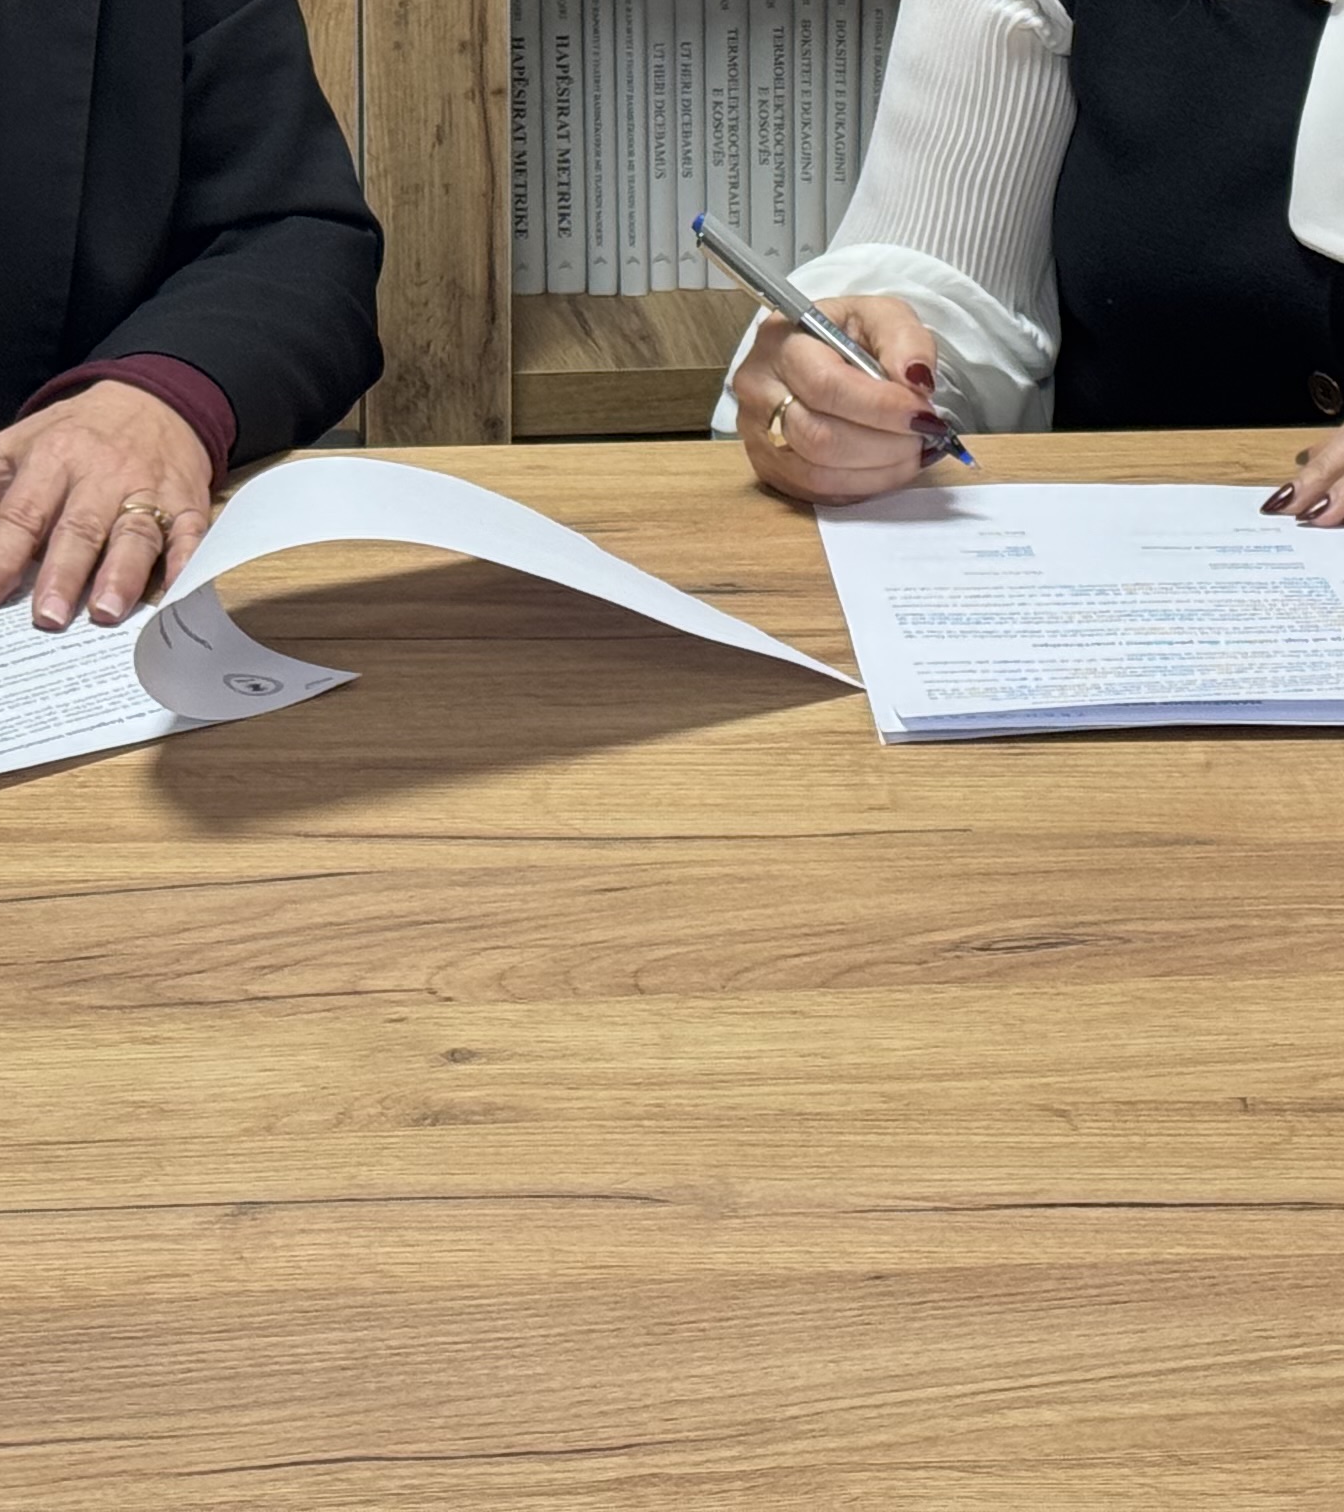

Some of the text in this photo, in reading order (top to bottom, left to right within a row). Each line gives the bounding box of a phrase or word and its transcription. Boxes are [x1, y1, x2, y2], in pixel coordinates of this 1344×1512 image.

[555, 34, 575, 144] HAPËSIRAT
[652, 41, 666, 60] UT
[799, 19, 813, 86] BOKSITET
[834, 19, 848, 85] BOKSITET
[653, 98, 668, 180] DICEBAMUS
[680, 40, 694, 179] UT HERI DICEBAMUS
[711, 99, 725, 168] KOSOVËS
[726, 27, 740, 228] TERMOELEKTROCENTRALET
[757, 97, 772, 166] KOSOVËS
[772, 25, 786, 227] TERMOELEKTROCENTRALET
[799, 100, 813, 185] DUKAGJINIT
[833, 100, 848, 185] DUKAGJINIT
[512, 149, 529, 241] METRIKE
[556, 147, 572, 239] METRIKE
